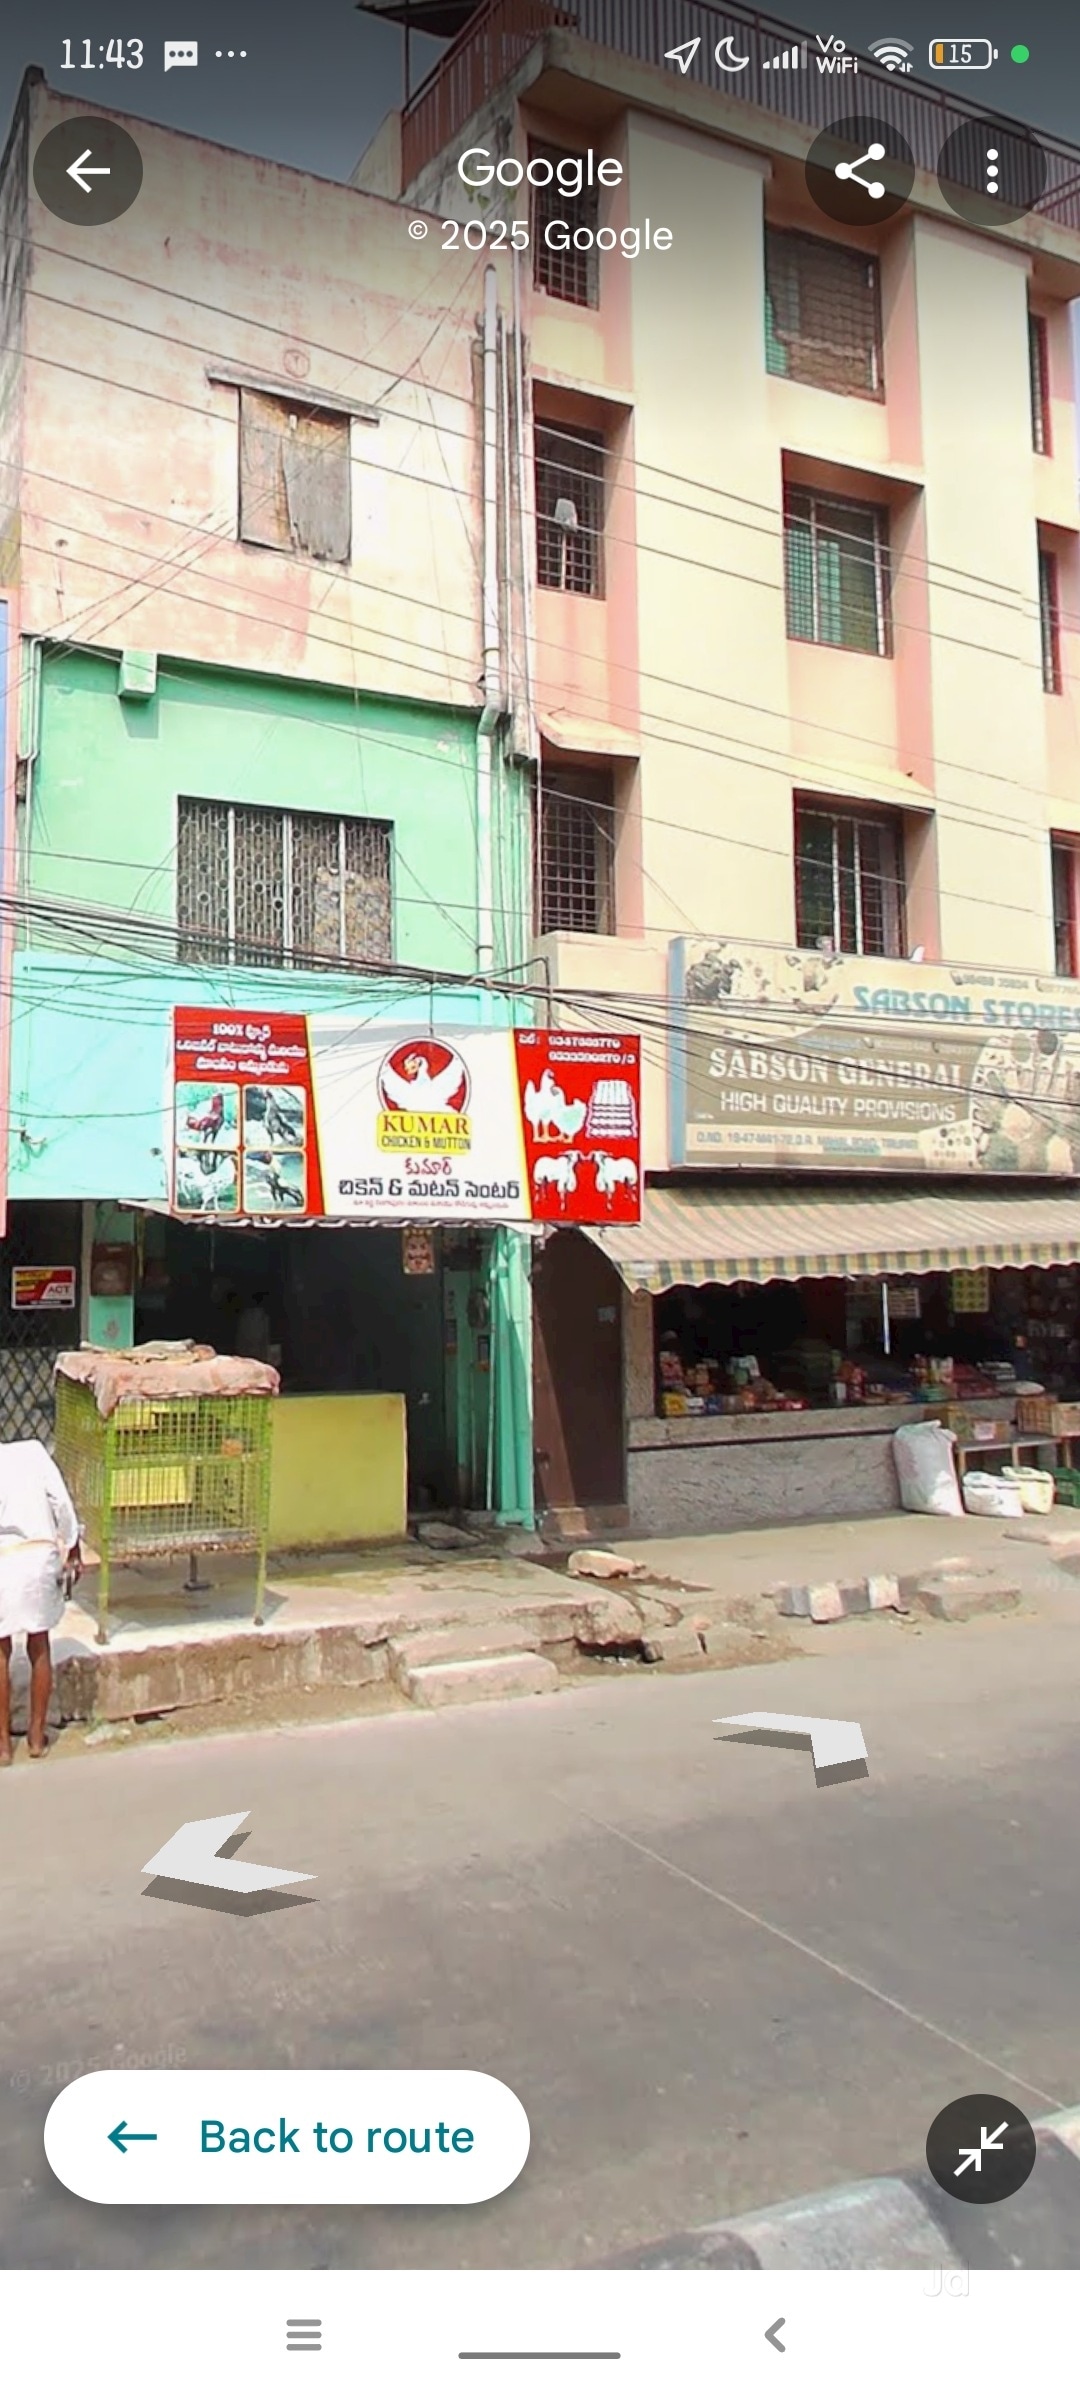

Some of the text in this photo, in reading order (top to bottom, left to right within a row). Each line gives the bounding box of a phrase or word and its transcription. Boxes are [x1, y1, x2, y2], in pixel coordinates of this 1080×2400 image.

[853, 985, 971, 1021] SABSON
[213, 1023, 244, 1037] 100%
[708, 1047, 829, 1085] SABSON
[836, 1056, 970, 1094] GENERAL
[720, 1091, 956, 1122] HIGH QUALITY PROVISIONS
[383, 1115, 470, 1135] KUMAR
[381, 1135, 421, 1149] CHICKEN
[433, 1138, 472, 1150] MUTTON
[404, 1156, 452, 1176] కుమార్
[388, 1178, 403, 1197] &
[408, 1180, 460, 1198] మటన్
[464, 1181, 521, 1200] సెంటర్
[48, 1284, 71, 1295] ACT
